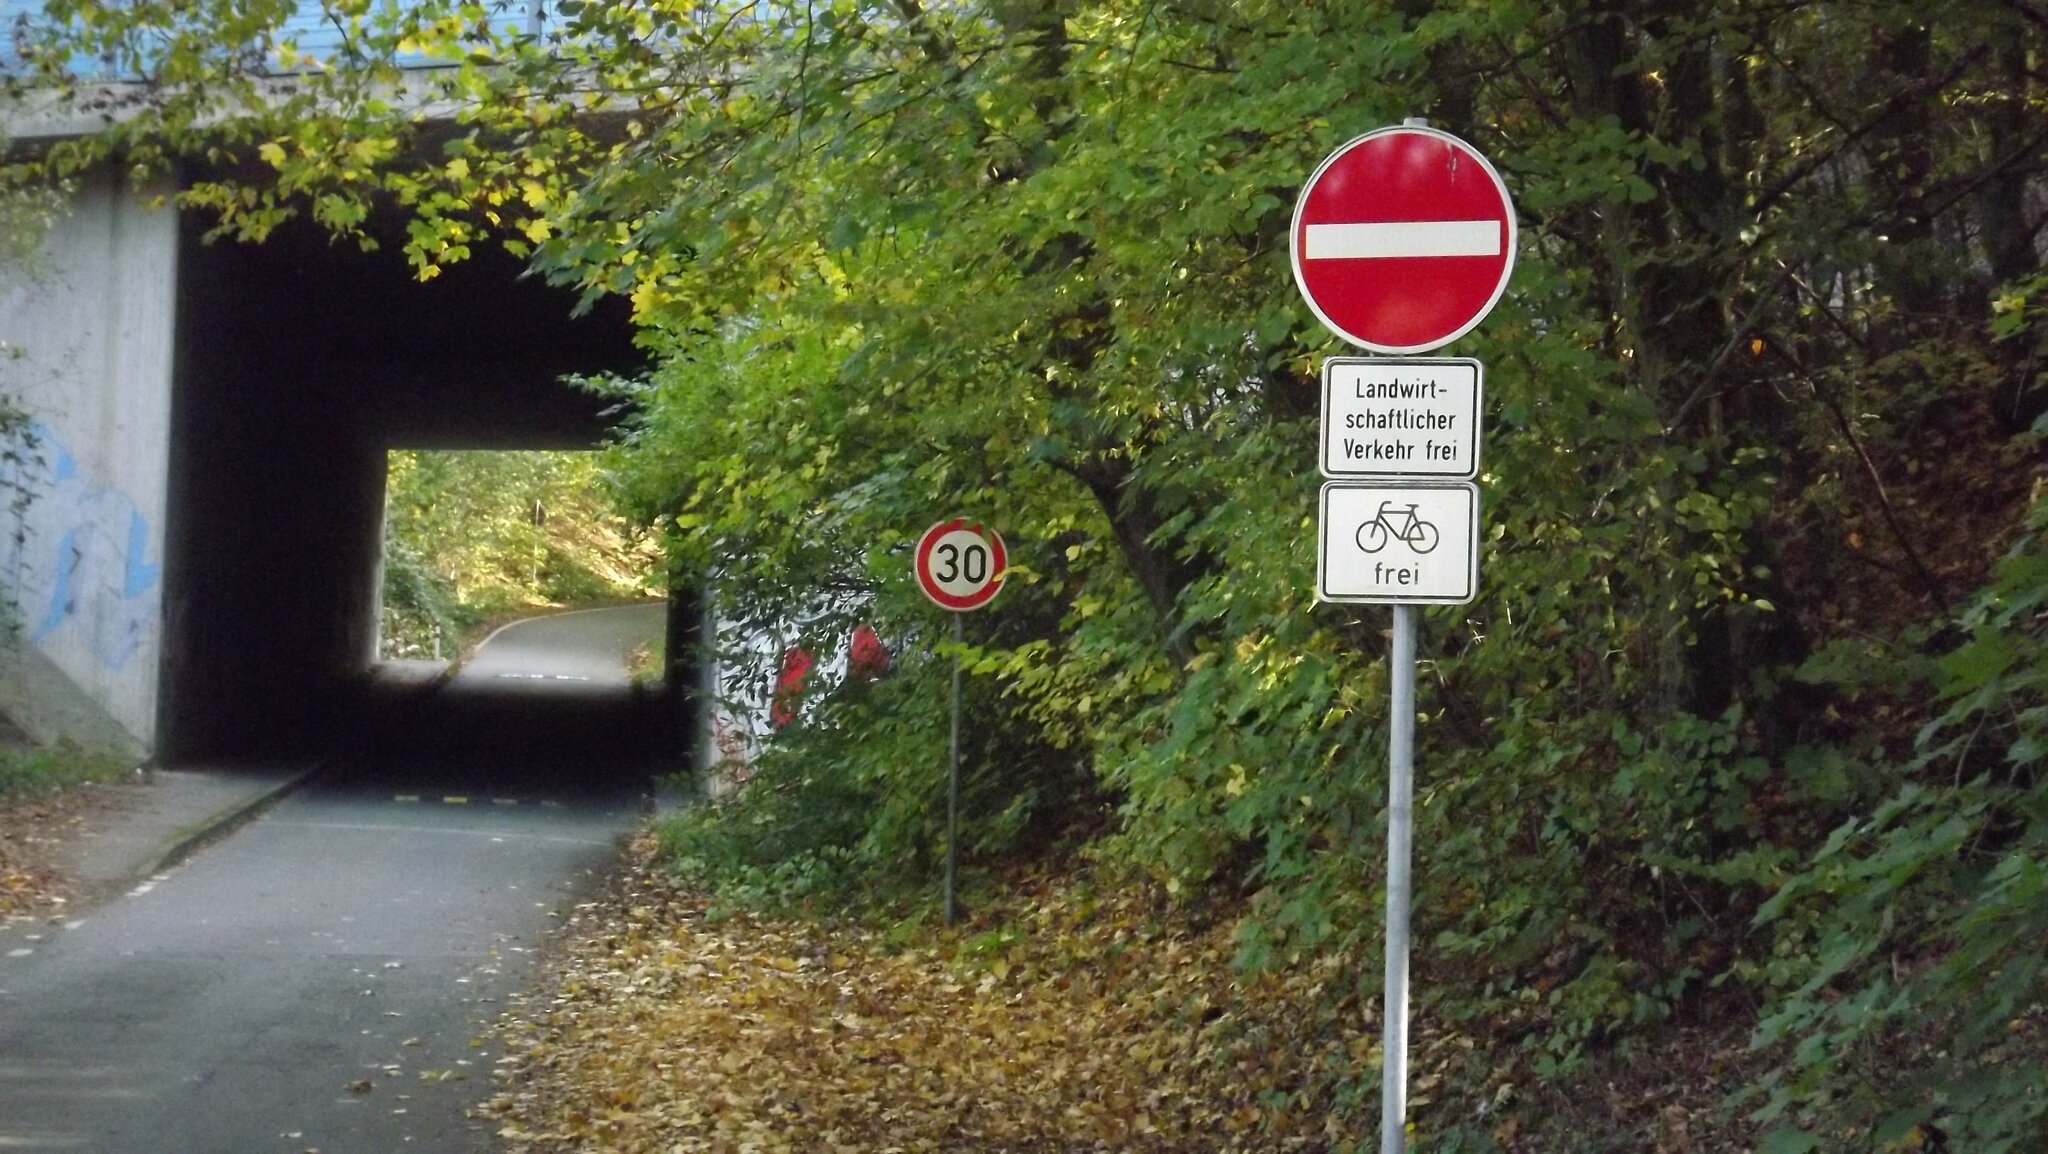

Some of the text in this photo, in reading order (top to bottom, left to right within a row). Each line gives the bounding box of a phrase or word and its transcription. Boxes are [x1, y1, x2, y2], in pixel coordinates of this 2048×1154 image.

[1356, 378, 1447, 399] Landwirt-
[1346, 409, 1456, 430] schaftlicher
[1344, 438, 1457, 461] Verkehr frei
[936, 544, 987, 584] 30
[1375, 562, 1419, 585] frei
